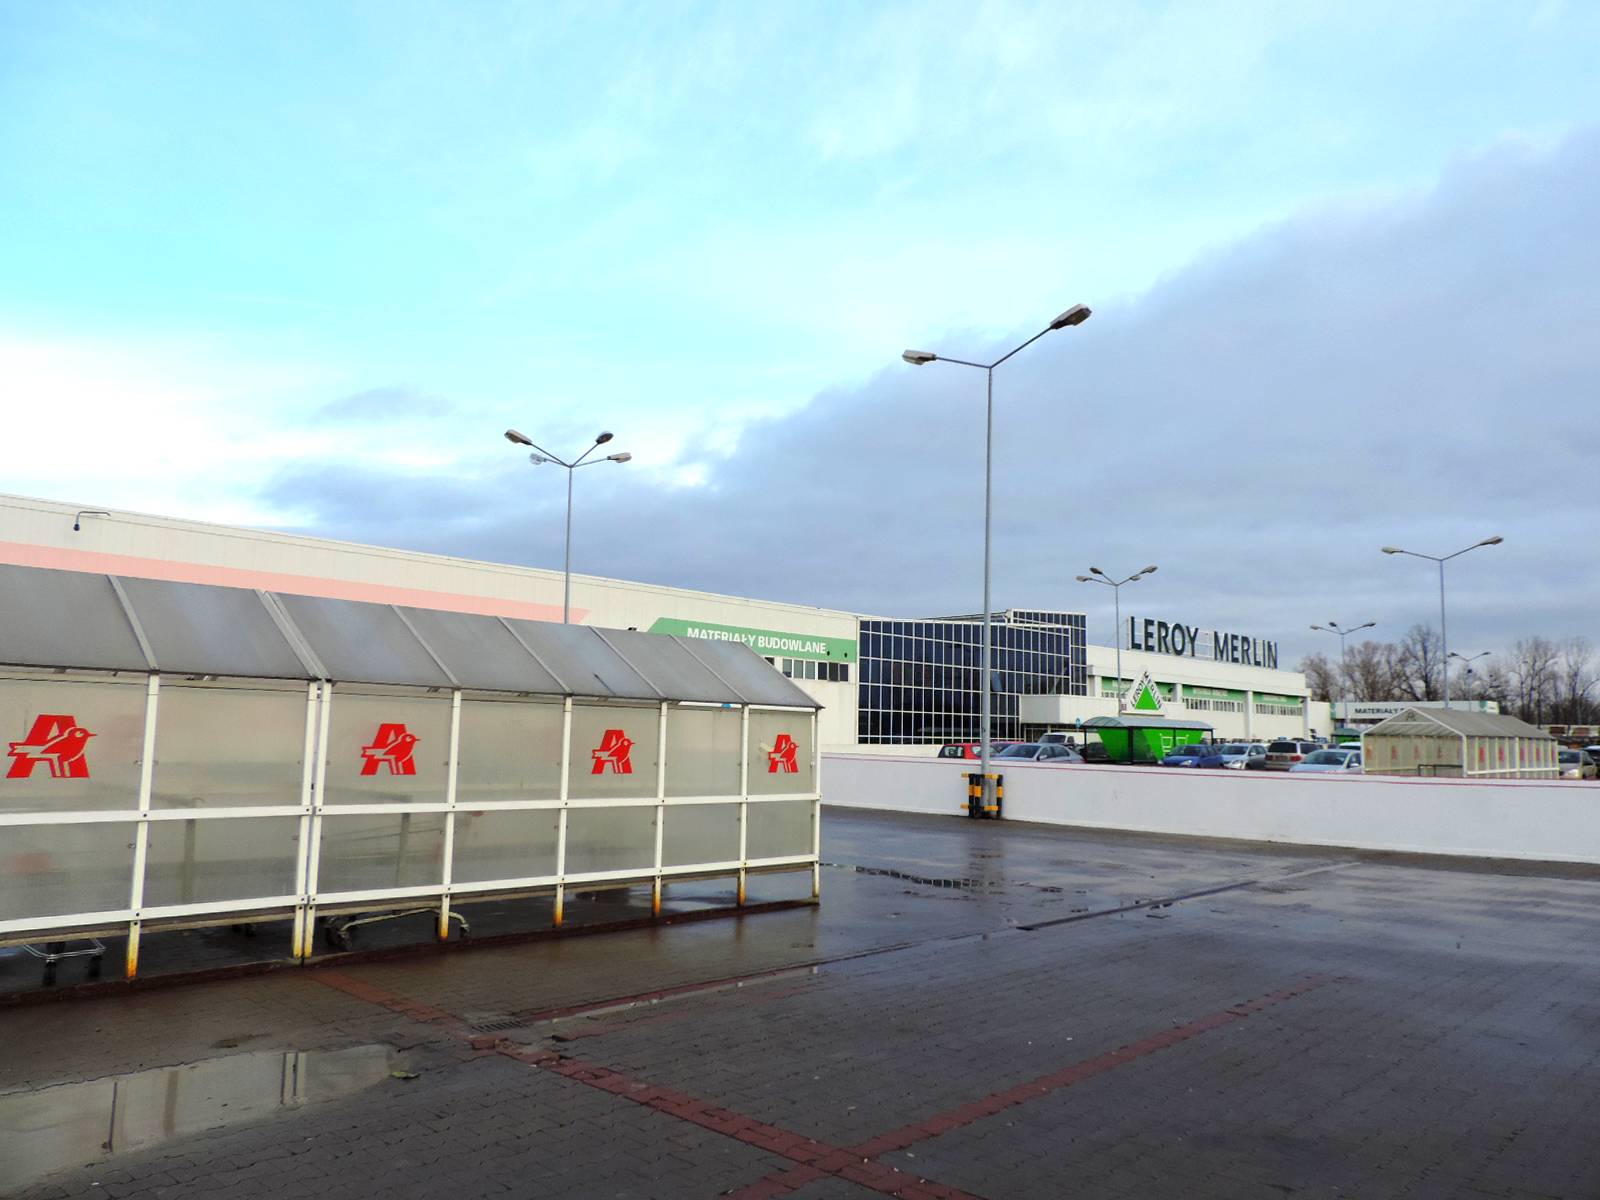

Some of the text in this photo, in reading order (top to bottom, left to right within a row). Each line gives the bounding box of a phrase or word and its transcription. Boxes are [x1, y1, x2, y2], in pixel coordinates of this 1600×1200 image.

[757, 635, 827, 654] BUDOWLANE
[1130, 615, 1278, 669] LEROY MERLIN
